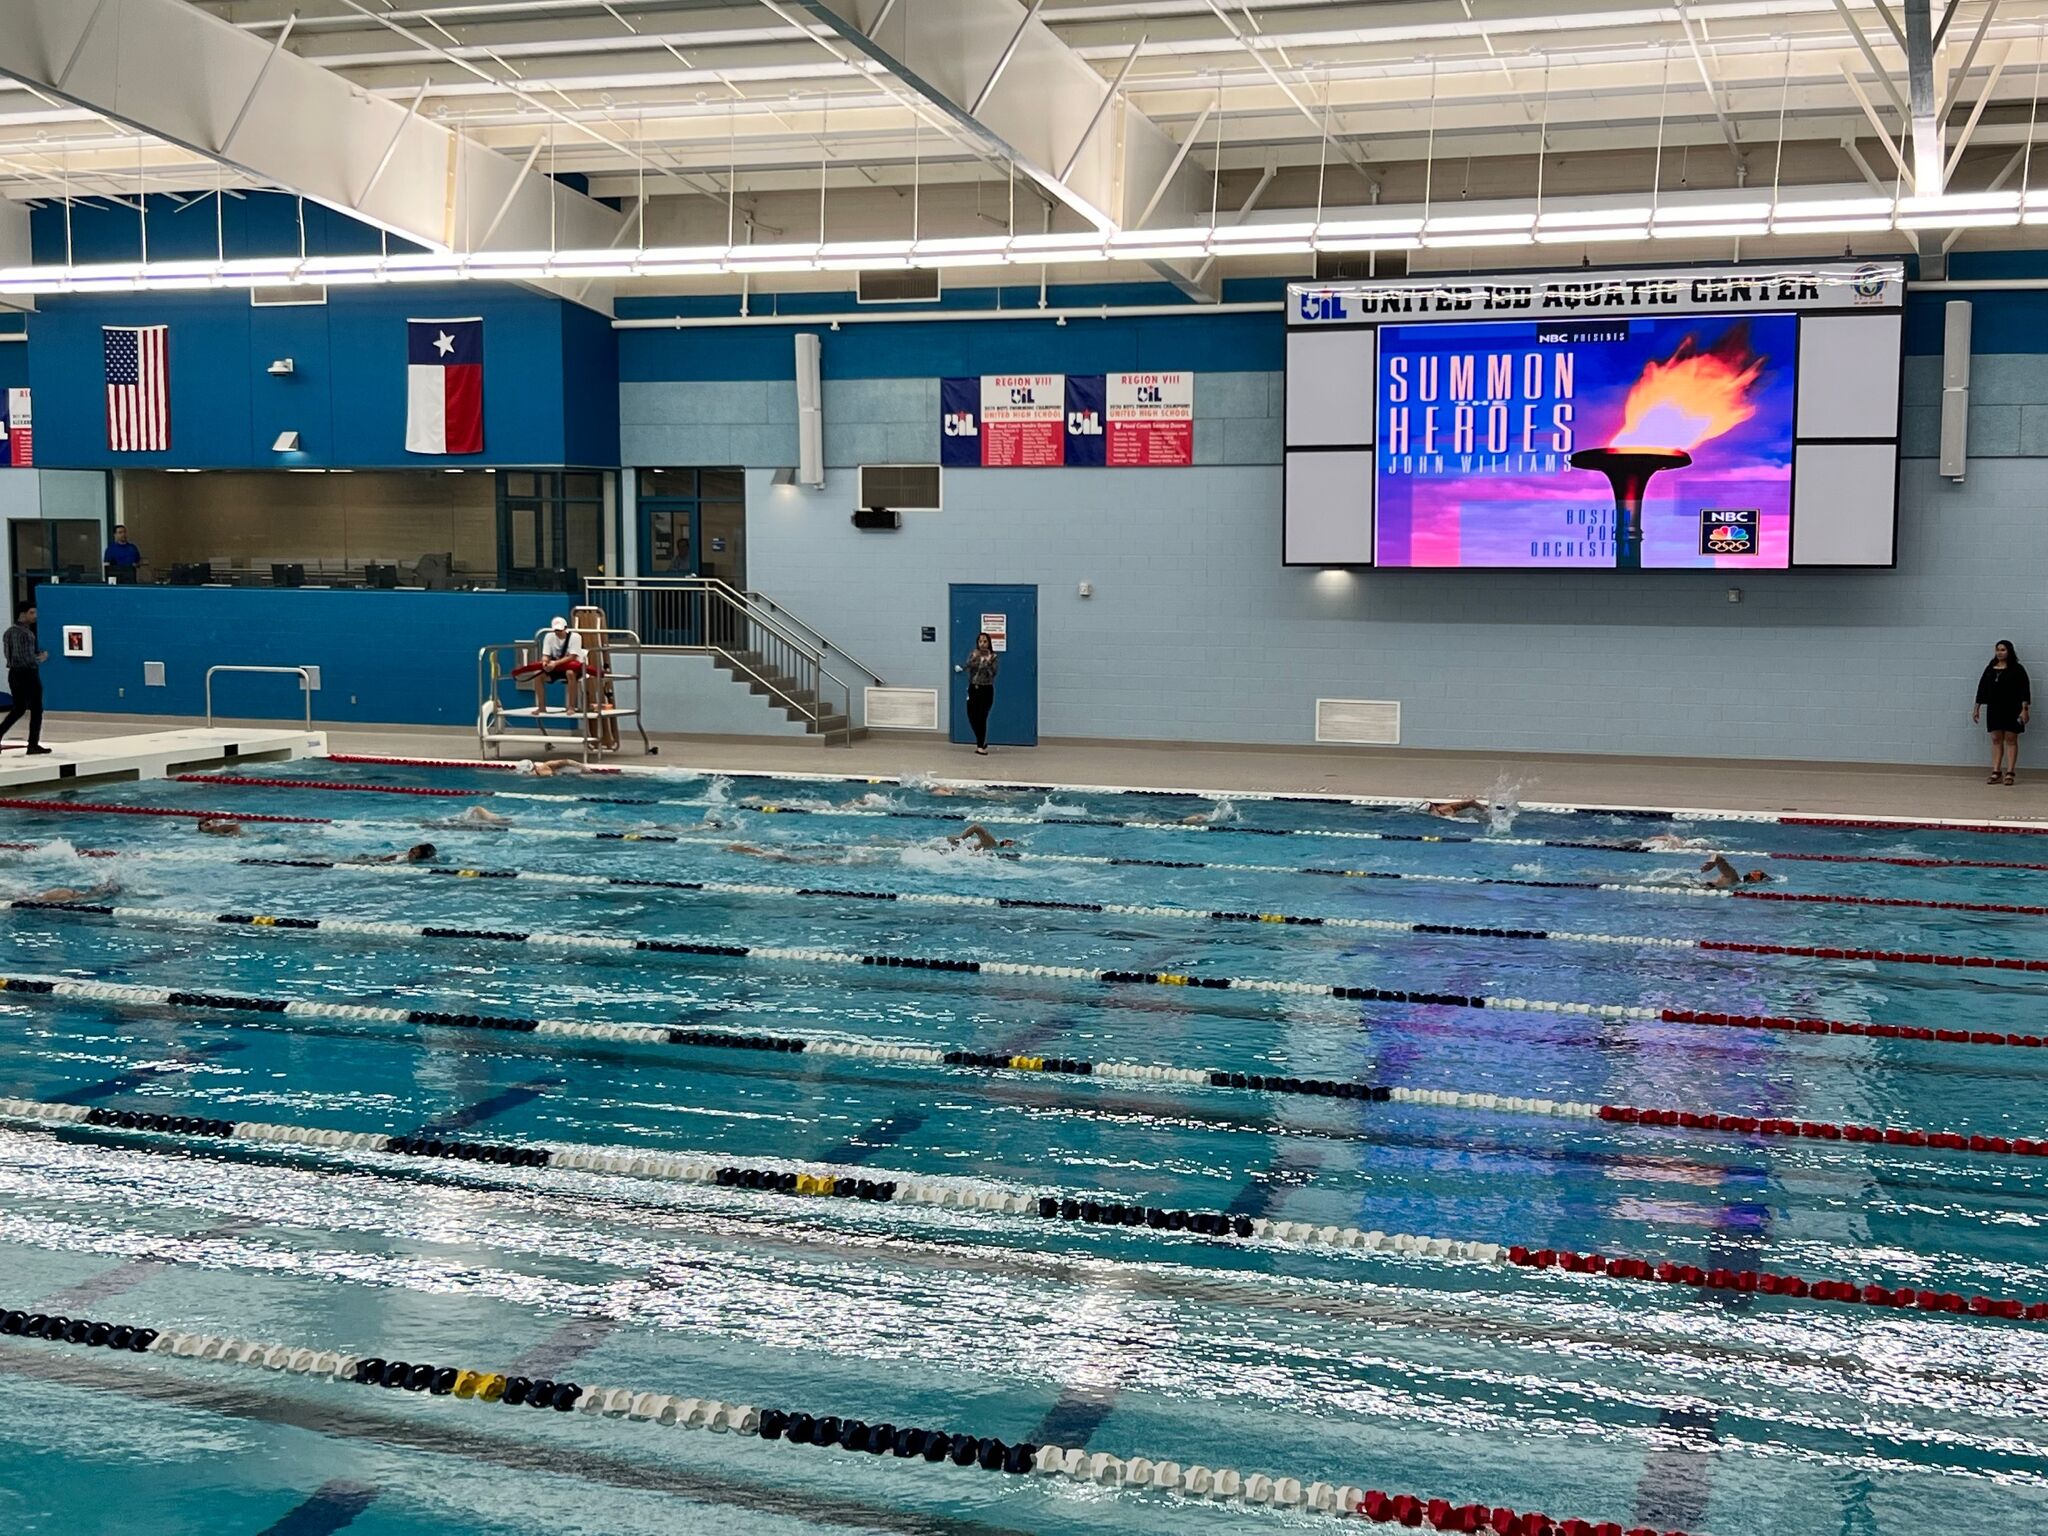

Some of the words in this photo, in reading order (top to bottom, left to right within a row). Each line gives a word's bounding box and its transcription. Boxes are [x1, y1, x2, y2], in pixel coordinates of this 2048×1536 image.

[1361, 287, 1472, 313] UNITED
[1483, 286, 1531, 310] ISD
[1542, 278, 1678, 310] AQUATIC
[1690, 275, 1819, 303] CENTER
[1539, 333, 1569, 343] NBC
[995, 377, 1031, 386] REGION
[1035, 377, 1052, 386] VIII
[1121, 375, 1158, 384] REGION
[1162, 375, 1180, 384] VIII
[1389, 352, 1574, 402] SUMMON
[984, 411, 1010, 419] UNITED
[1034, 410, 1061, 418] SCHOOL
[1110, 410, 1136, 418] UNITED
[1139, 409, 1159, 417] HIGH
[1161, 409, 1190, 417] SCHOOL
[1389, 404, 1573, 455] HEROES
[1389, 455, 1444, 475] JOHN
[1460, 453, 1572, 474] WILLIAMS
[1711, 511, 1748, 522] NBC
[1587, 525, 1630, 541] POP
